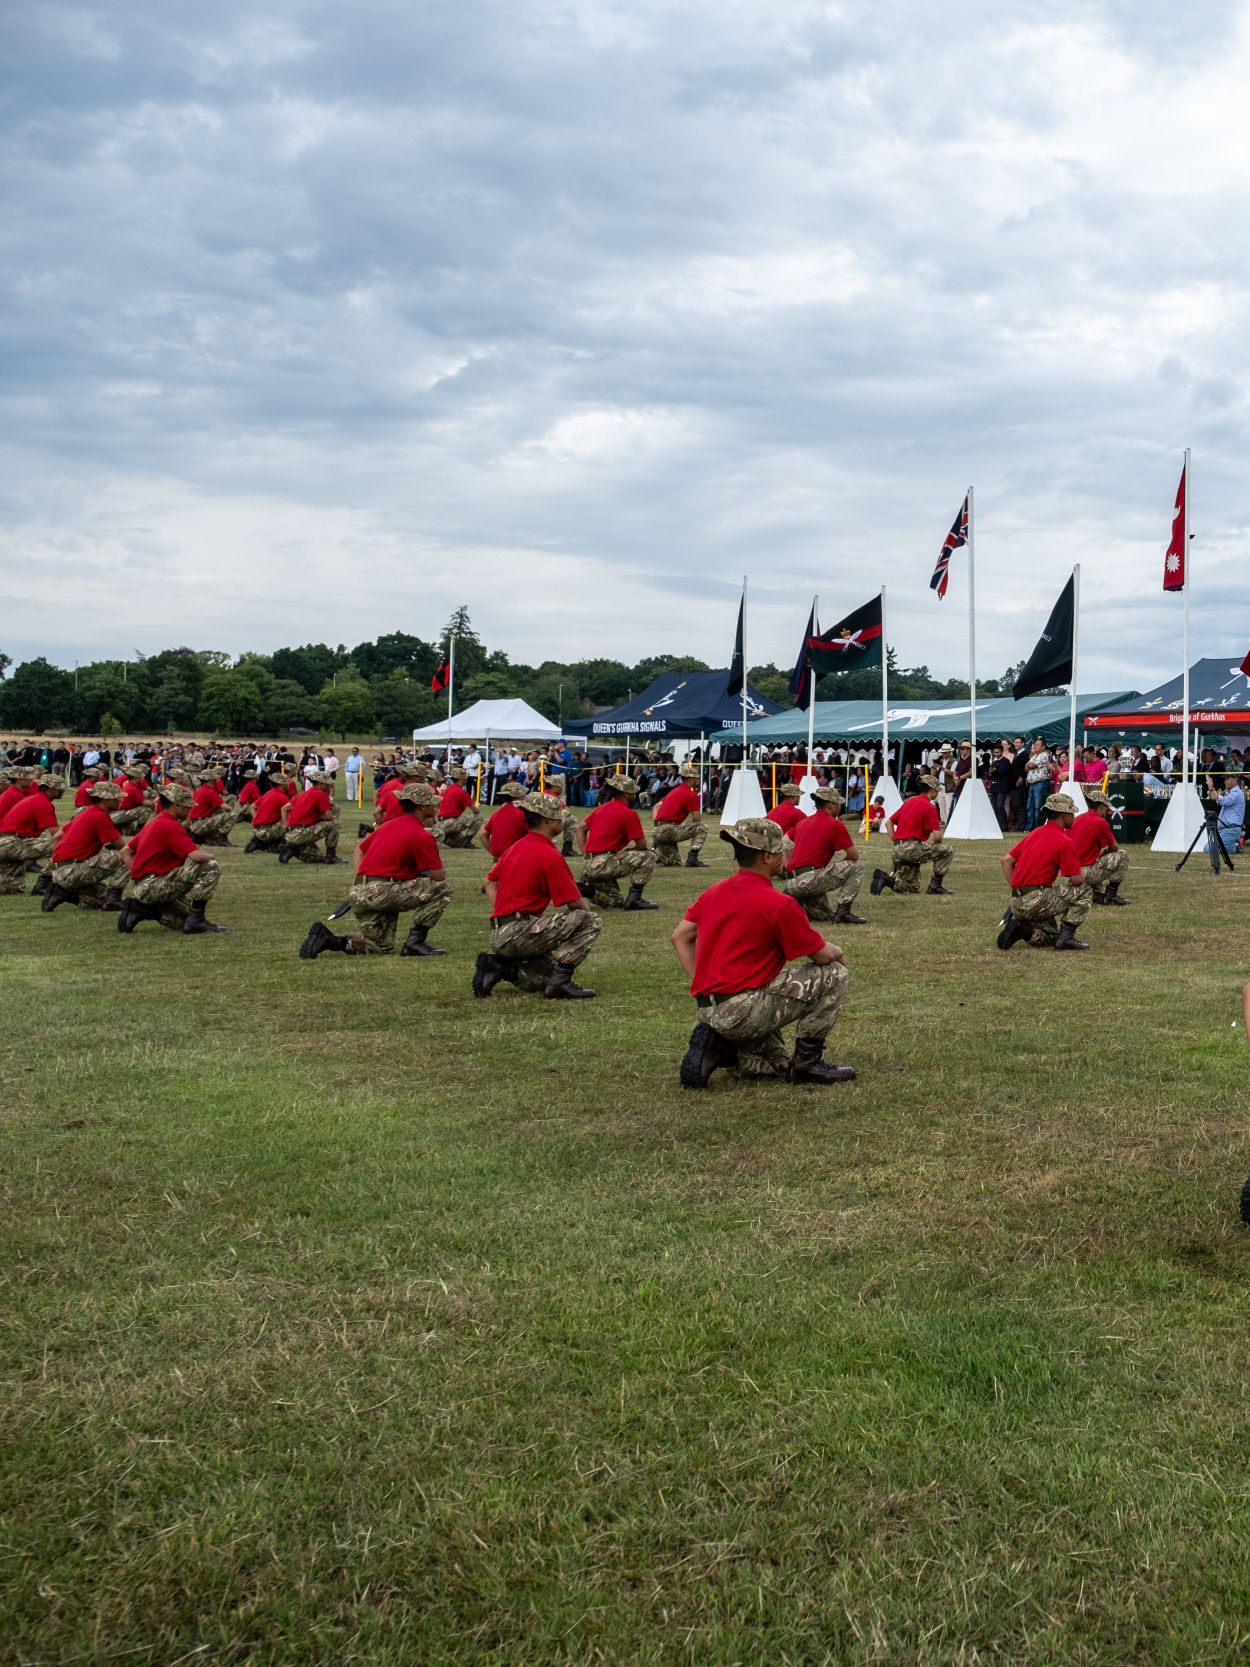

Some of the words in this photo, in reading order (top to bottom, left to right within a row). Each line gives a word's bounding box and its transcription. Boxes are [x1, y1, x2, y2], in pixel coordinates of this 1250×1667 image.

[1193, 712, 1200, 721] of
[1200, 712, 1225, 721] Gurkhas
[593, 722, 616, 733] QUEEN'S
[616, 721, 639, 733] GURKHA
[640, 720, 666, 732] SIGNALS
